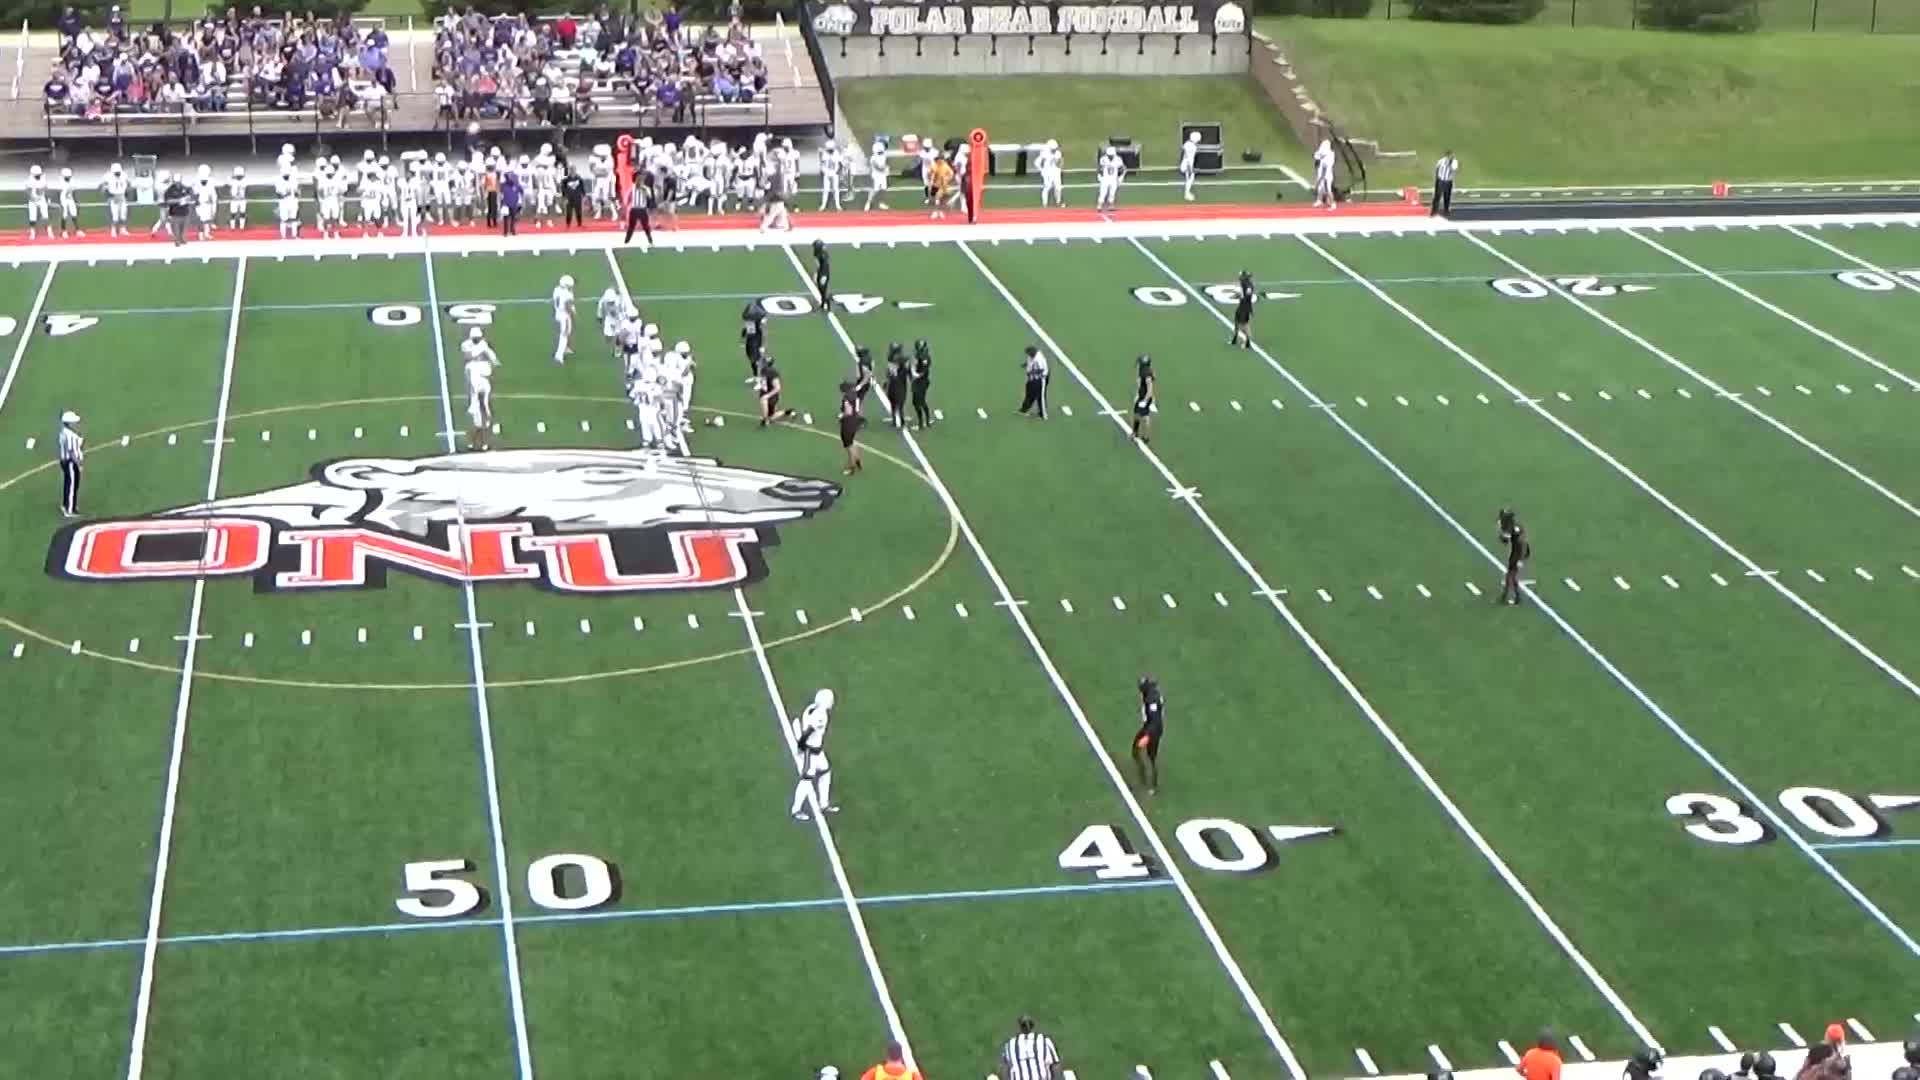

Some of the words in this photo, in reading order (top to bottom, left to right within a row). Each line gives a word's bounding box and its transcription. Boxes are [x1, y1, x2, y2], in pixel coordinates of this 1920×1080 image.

[869, 6, 967, 35] POLAR
[971, 6, 1052, 34] BEAR
[1057, 6, 1199, 34] FOOTBALL
[372, 304, 496, 325] 50
[63, 517, 759, 592] ONU
[1665, 787, 1881, 844] 30
[1058, 818, 1270, 880] 40
[396, 854, 612, 917] 50
